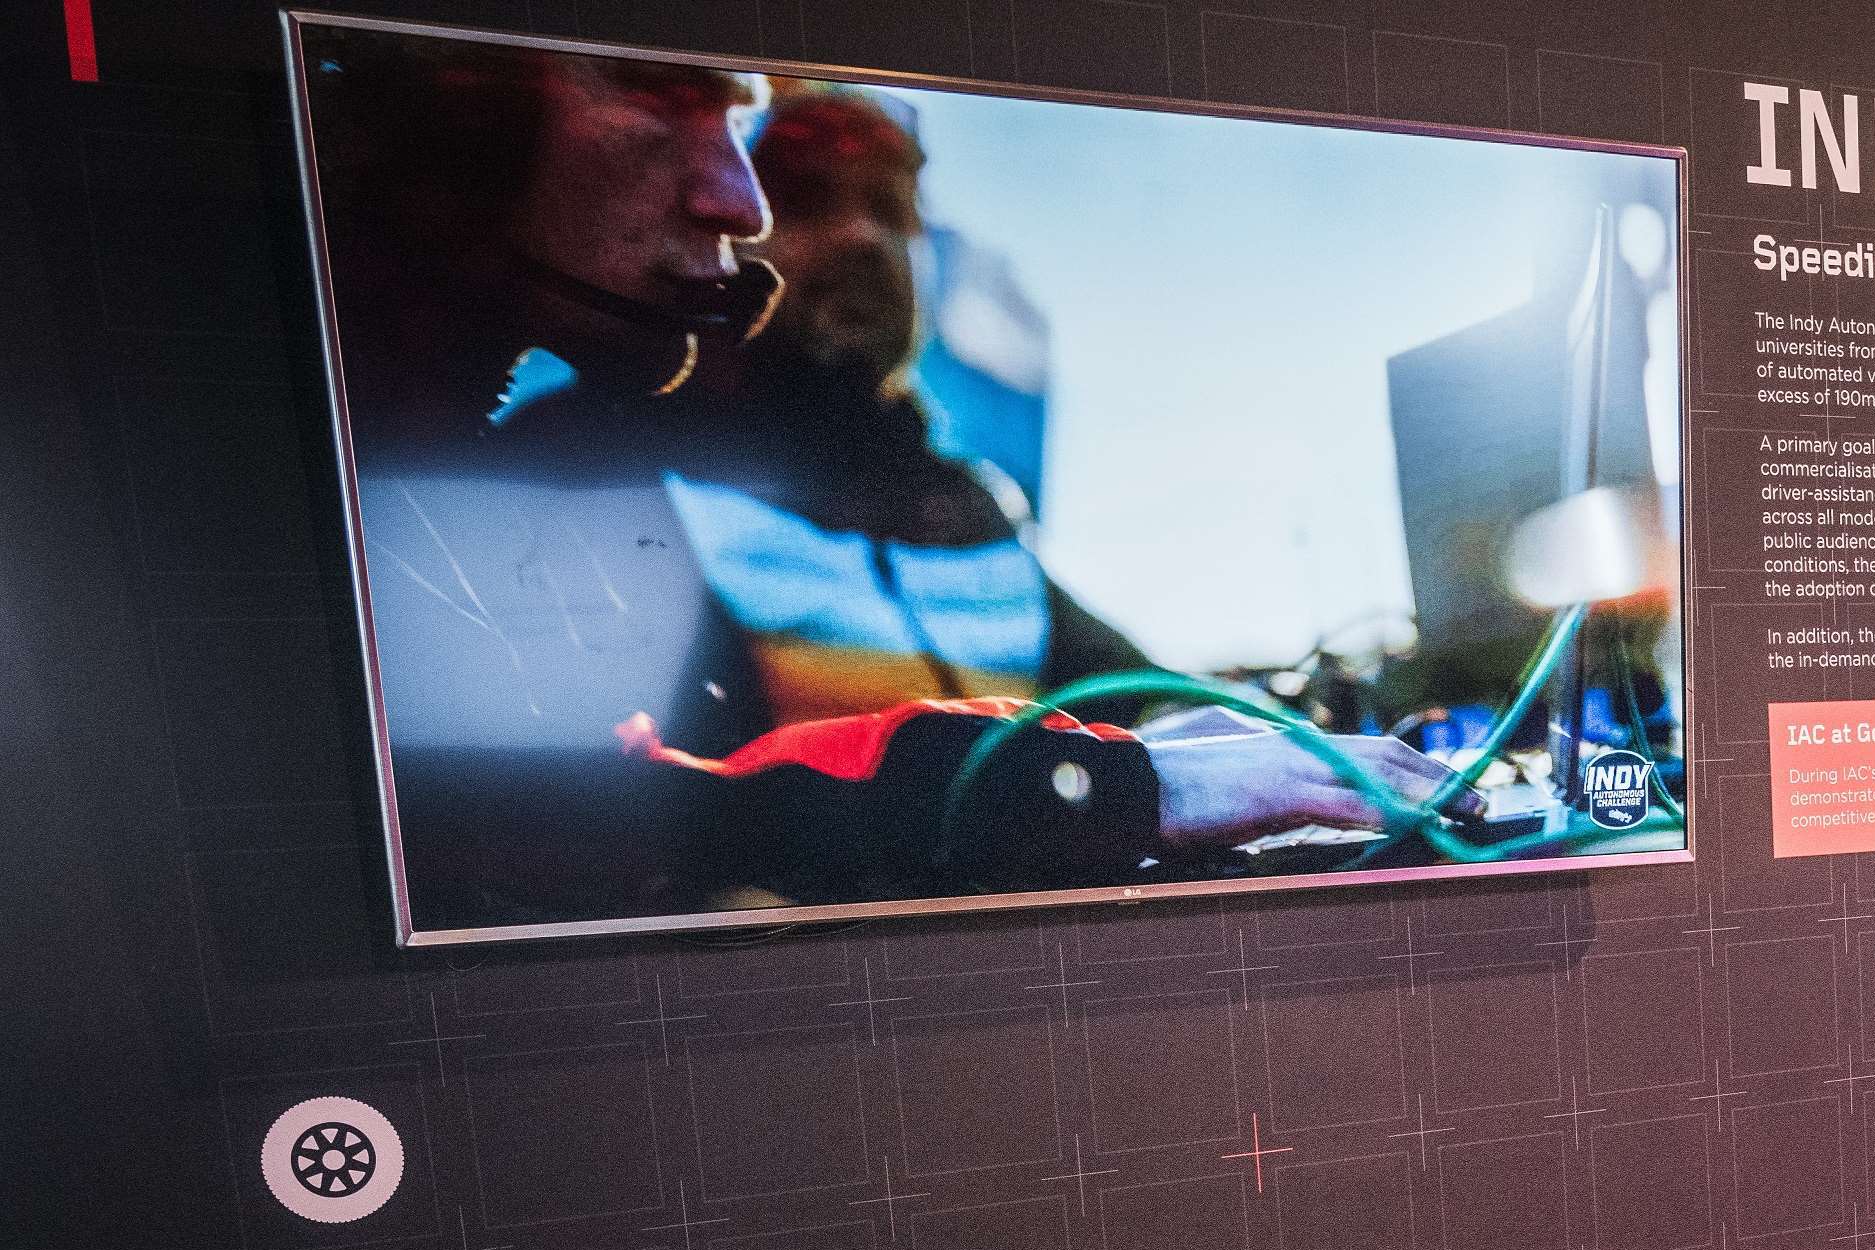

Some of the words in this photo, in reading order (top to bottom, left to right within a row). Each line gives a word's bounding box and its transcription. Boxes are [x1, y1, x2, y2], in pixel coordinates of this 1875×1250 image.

[1755, 312, 1784, 329] The
[1790, 314, 1823, 334] Indy
[1756, 338, 1844, 357] universities
[1757, 362, 1773, 377] of
[1778, 364, 1862, 383] automated
[1758, 390, 1809, 404] excess
[1814, 391, 1830, 405] of
[1765, 580, 1790, 596] the
[1795, 580, 1865, 599] adoption
[1788, 725, 1825, 745] IAC
[1832, 724, 1851, 743] at
[1587, 764, 1651, 791] INDY
[1593, 789, 1645, 800] AUTONOMOUS
[1597, 797, 1641, 807] CHALLENGE
[1791, 811, 1875, 828] competitive
